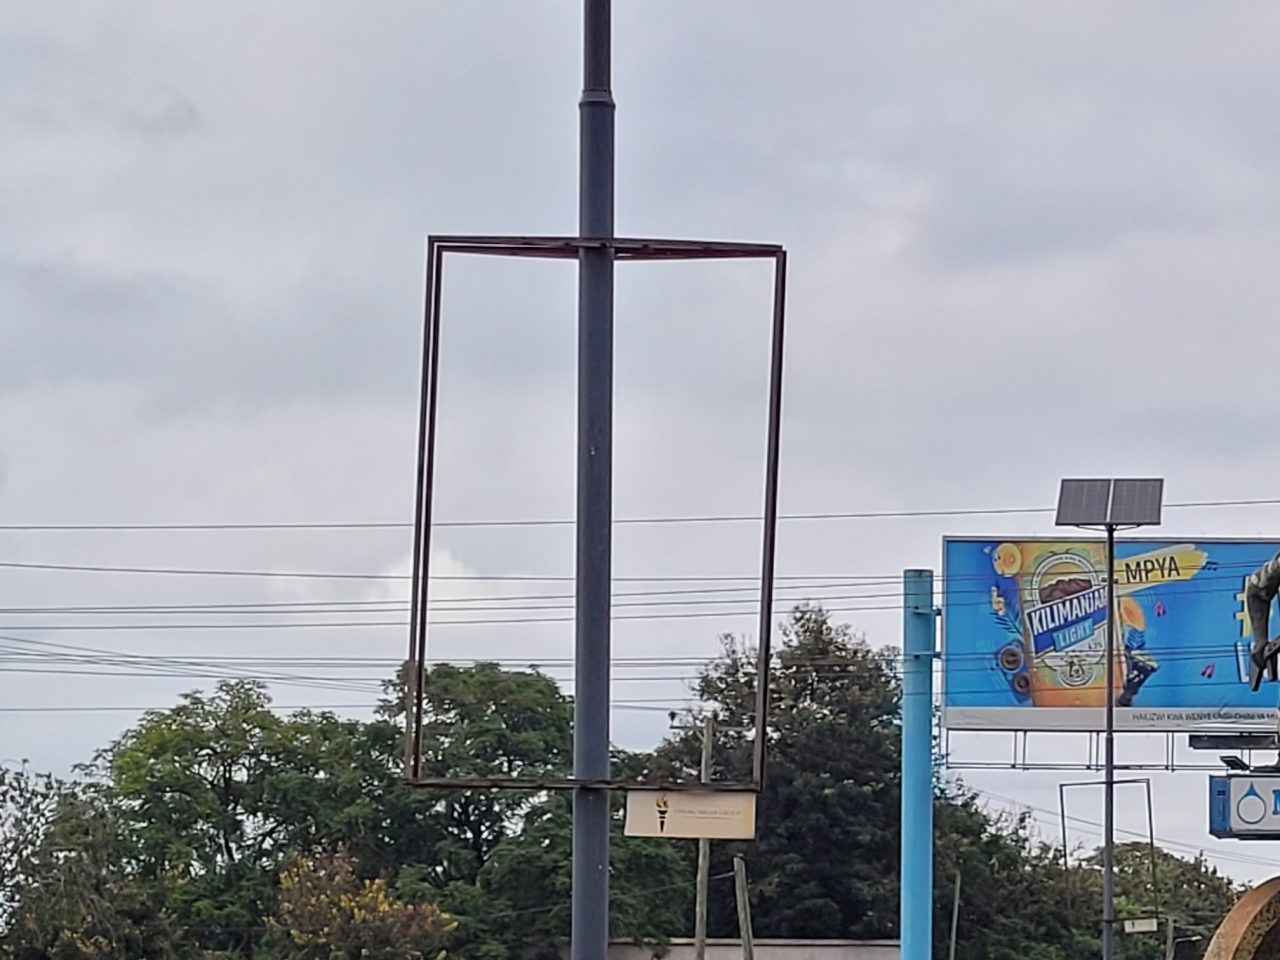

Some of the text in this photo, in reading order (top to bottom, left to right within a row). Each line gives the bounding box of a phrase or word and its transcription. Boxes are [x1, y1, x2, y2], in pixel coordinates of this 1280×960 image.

[1125, 556, 1181, 584] MPYA
[1030, 587, 1108, 636] KILIMANJA
[1059, 622, 1091, 647] LIGHT
